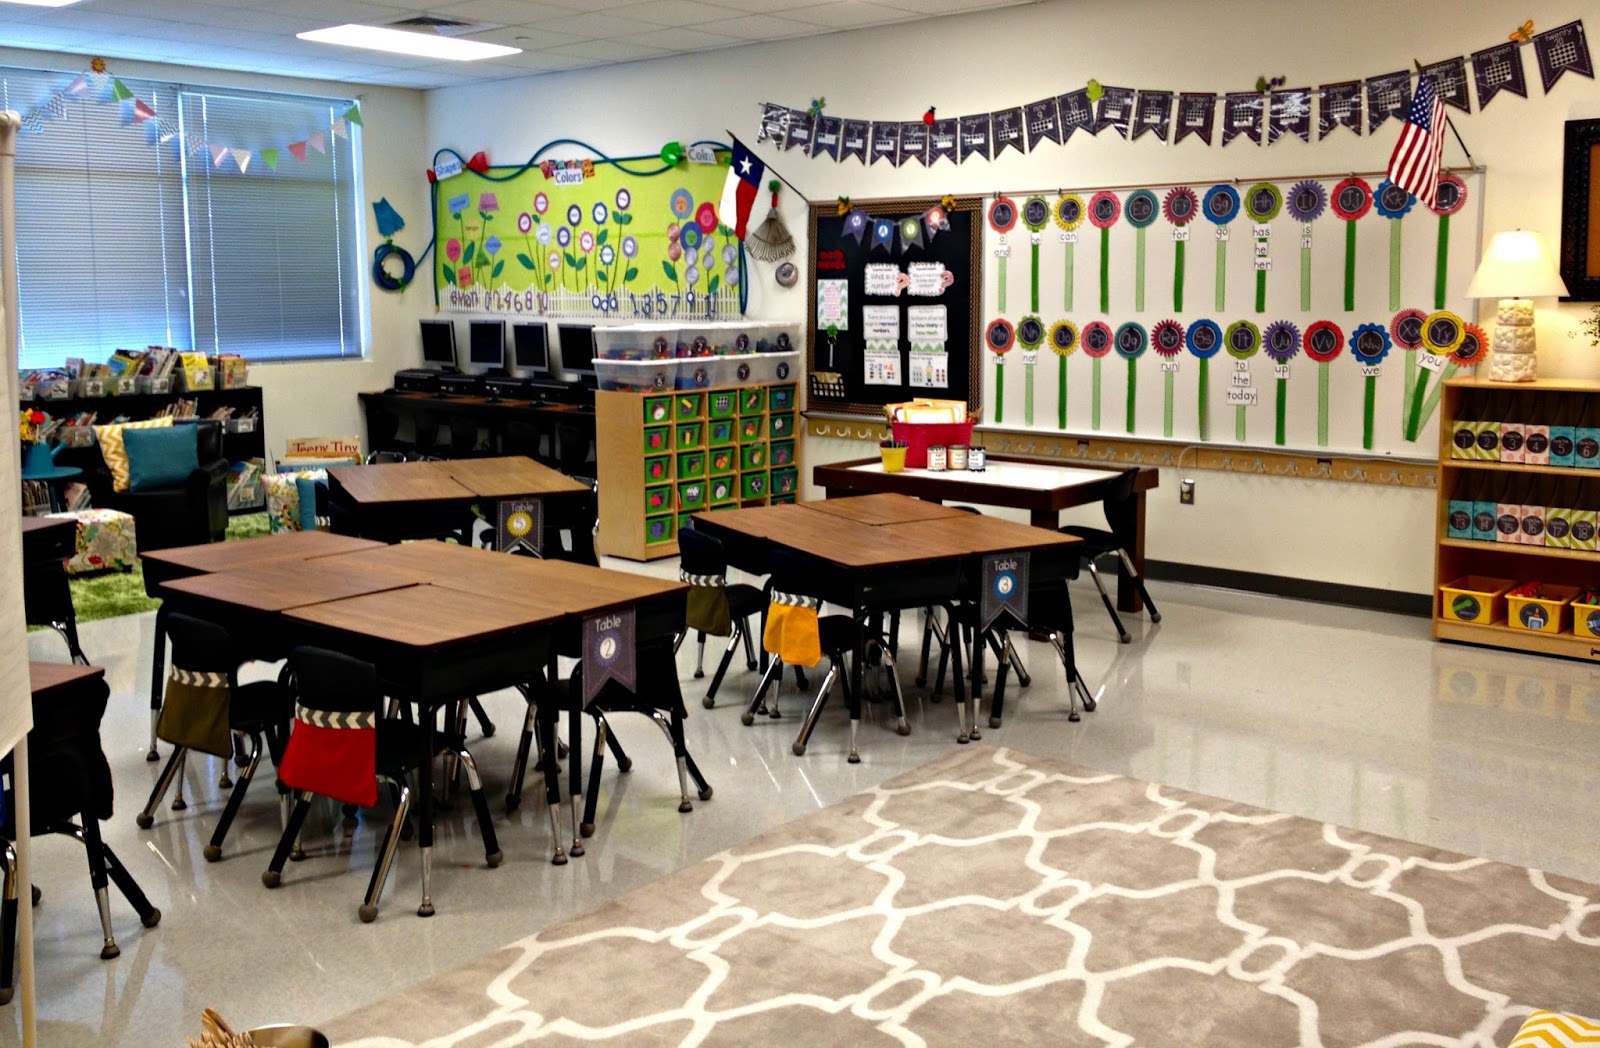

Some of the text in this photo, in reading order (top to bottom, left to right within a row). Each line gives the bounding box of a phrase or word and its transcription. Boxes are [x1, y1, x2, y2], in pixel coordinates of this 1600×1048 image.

[1546, 28, 1572, 40] twenty
[1554, 38, 1564, 47] 20
[1071, 102, 1078, 113] 10
[1038, 111, 1043, 119] 9
[436, 161, 461, 174] Shapes
[556, 171, 582, 183] Colors
[1175, 199, 1189, 211] Ff
[1213, 196, 1229, 212] Gg
[1255, 195, 1272, 208] Hh
[1343, 191, 1359, 208] Jj
[995, 207, 1009, 220] Aa
[1028, 206, 1043, 219] Bb
[1097, 204, 1112, 215] Dd
[1133, 202, 1150, 215] Ee
[1172, 228, 1188, 239] for
[1216, 229, 1228, 239] go
[1253, 225, 1270, 236] has
[1255, 243, 1266, 254] he
[1303, 239, 1310, 248] it
[994, 248, 1010, 256] and
[1254, 259, 1271, 269] her
[514, 294, 523, 312] 6
[525, 291, 532, 310] 8
[592, 291, 618, 315] odd
[630, 293, 638, 316] 1
[642, 294, 651, 315] 3
[657, 293, 667, 314] 5
[671, 295, 680, 316] 7
[687, 291, 694, 313] 9
[993, 328, 1008, 340] Mm
[1023, 326, 1038, 338] Nn
[1059, 331, 1070, 343] Oo
[1162, 332, 1177, 344] Rr
[1196, 331, 1212, 345] Ss
[1435, 324, 1450, 343] Yy
[740, 340, 744, 348] 3
[1091, 332, 1104, 346] Pp
[1121, 332, 1138, 349] Qq
[1236, 332, 1250, 347] Tt
[1274, 335, 1289, 348] Uu
[1315, 334, 1332, 349] Vv
[1361, 337, 1380, 350] Ww
[658, 344, 662, 352] 1
[698, 344, 702, 352] 2
[1236, 361, 1245, 369] to
[1419, 353, 1442, 367] you
[1275, 366, 1288, 376] up
[657, 378, 662, 386] 5
[1233, 374, 1249, 384] the
[1227, 390, 1256, 403] today
[331, 441, 357, 452] Tiny
[1462, 438, 1466, 448] 1
[1483, 438, 1490, 447] 2
[1509, 438, 1516, 450] 3
[1533, 441, 1539, 451] 4
[1558, 444, 1565, 454] 5
[1583, 445, 1590, 457] 6
[512, 501, 534, 511] Table
[516, 518, 523, 529] 5
[1455, 519, 1466, 529] 13
[1504, 523, 1513, 533] 15
[1527, 522, 1536, 533] 16
[1553, 526, 1562, 537] 17
[1579, 527, 1589, 538] 18
[994, 559, 1017, 571] Table
[1001, 577, 1009, 592] 3
[595, 614, 622, 632] Table
[603, 639, 611, 657] 2
